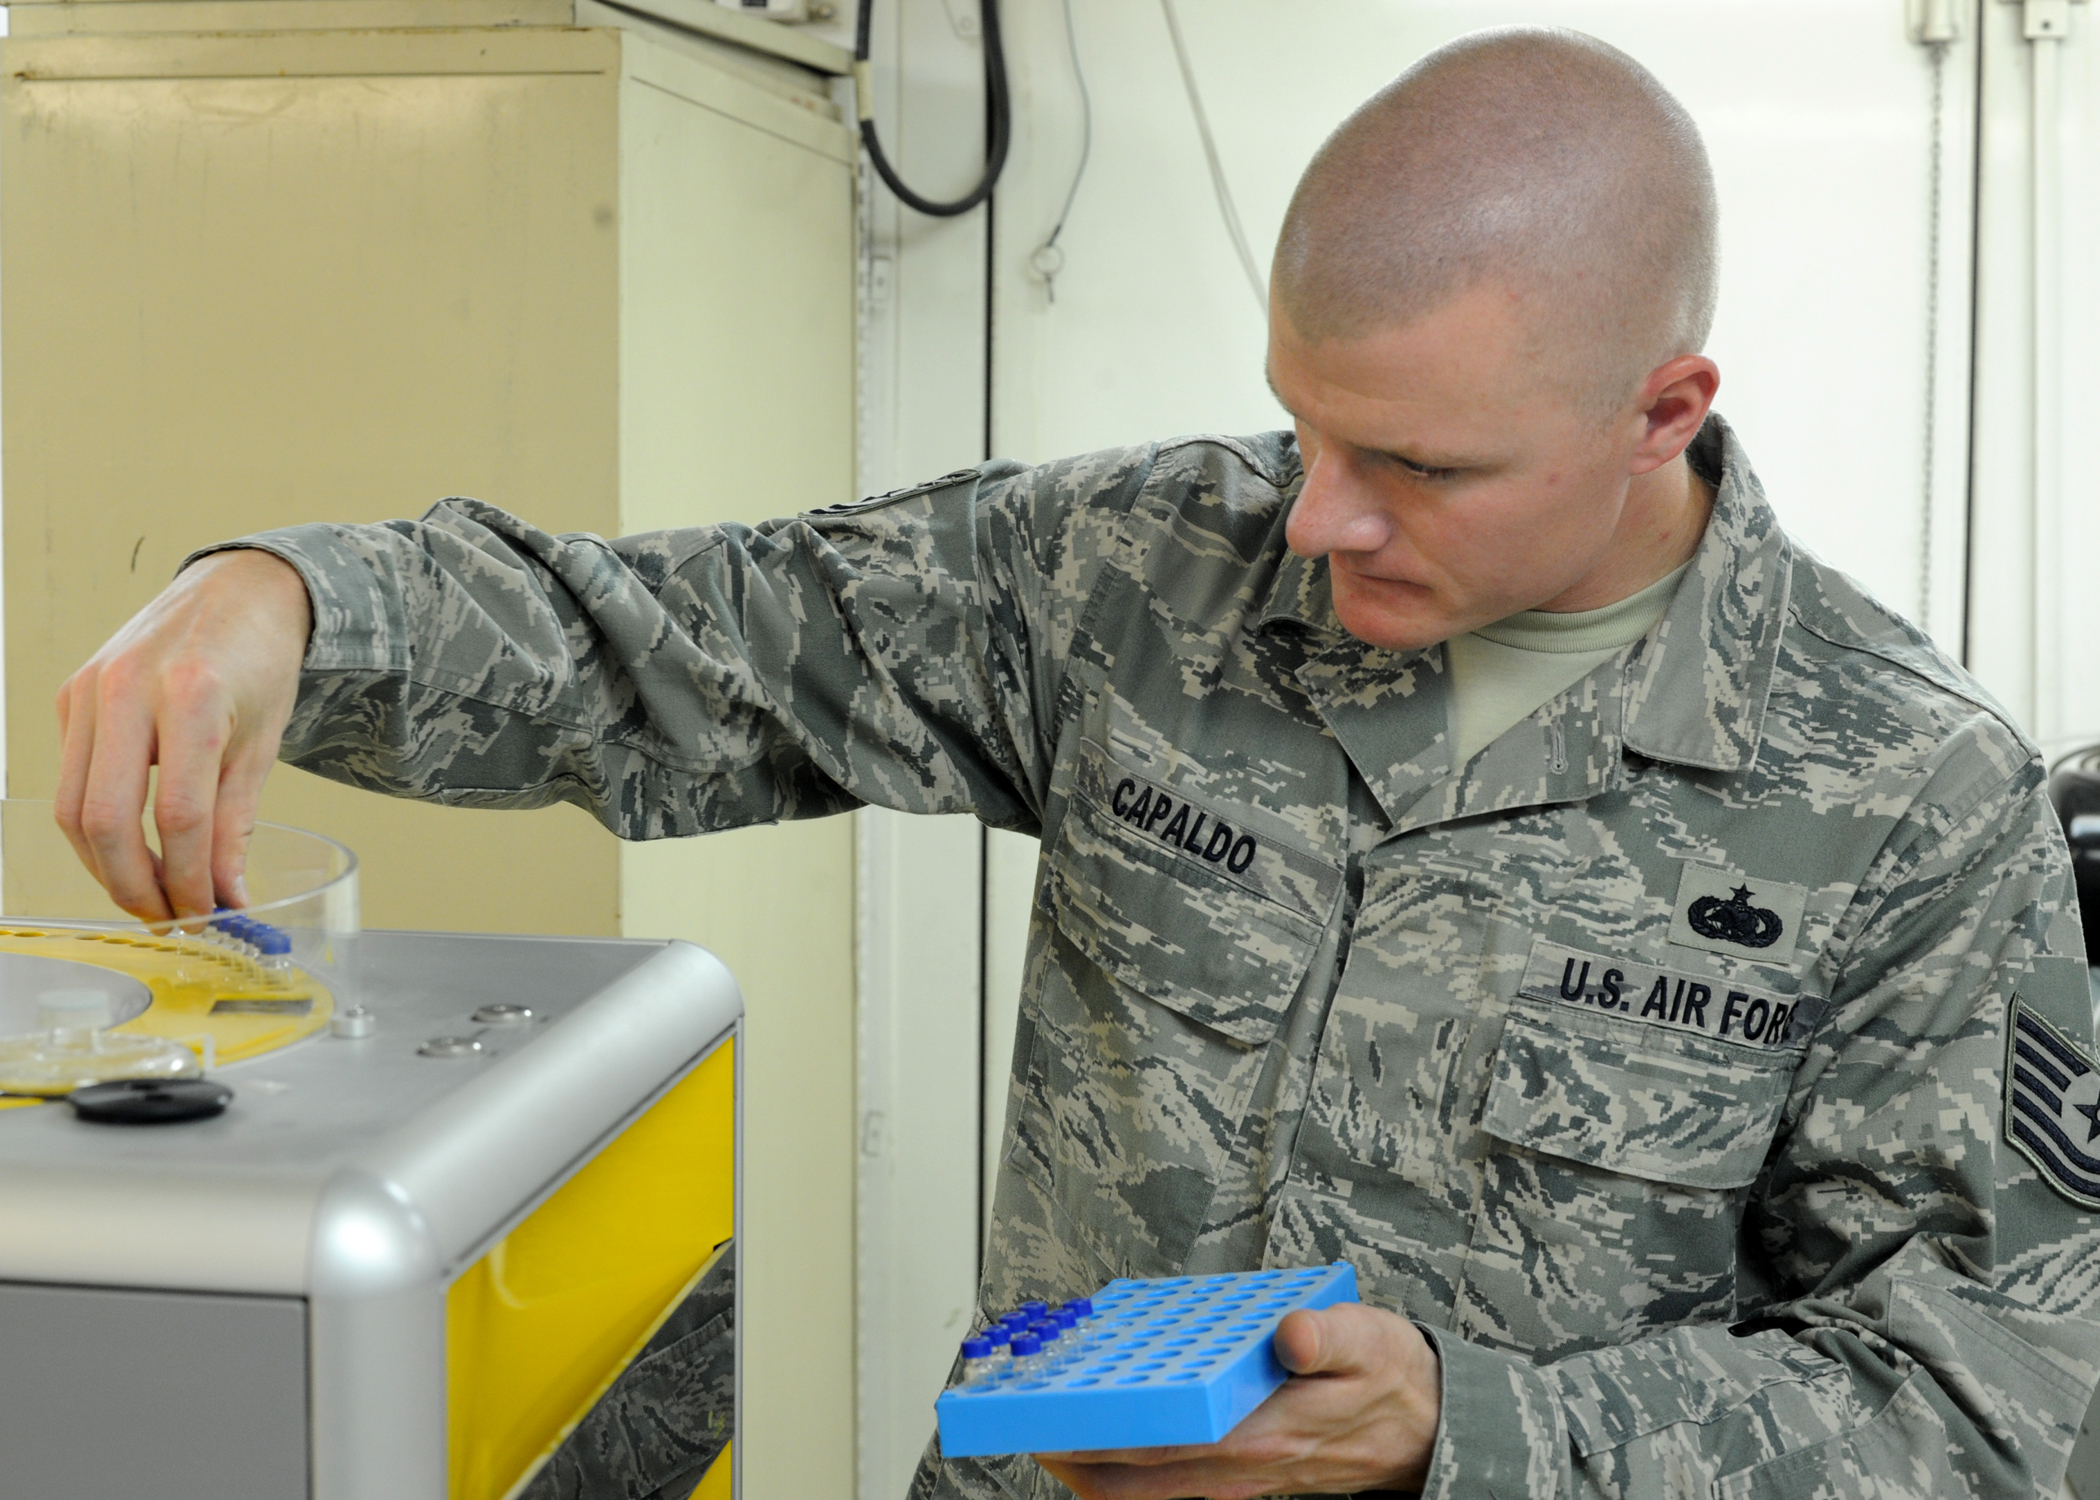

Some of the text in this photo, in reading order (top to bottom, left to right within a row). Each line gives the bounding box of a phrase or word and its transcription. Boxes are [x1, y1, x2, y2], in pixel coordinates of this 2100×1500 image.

[1112, 778, 1256, 874] CAPALDO
[1560, 958, 1800, 1043] U.S. AIR FOR
